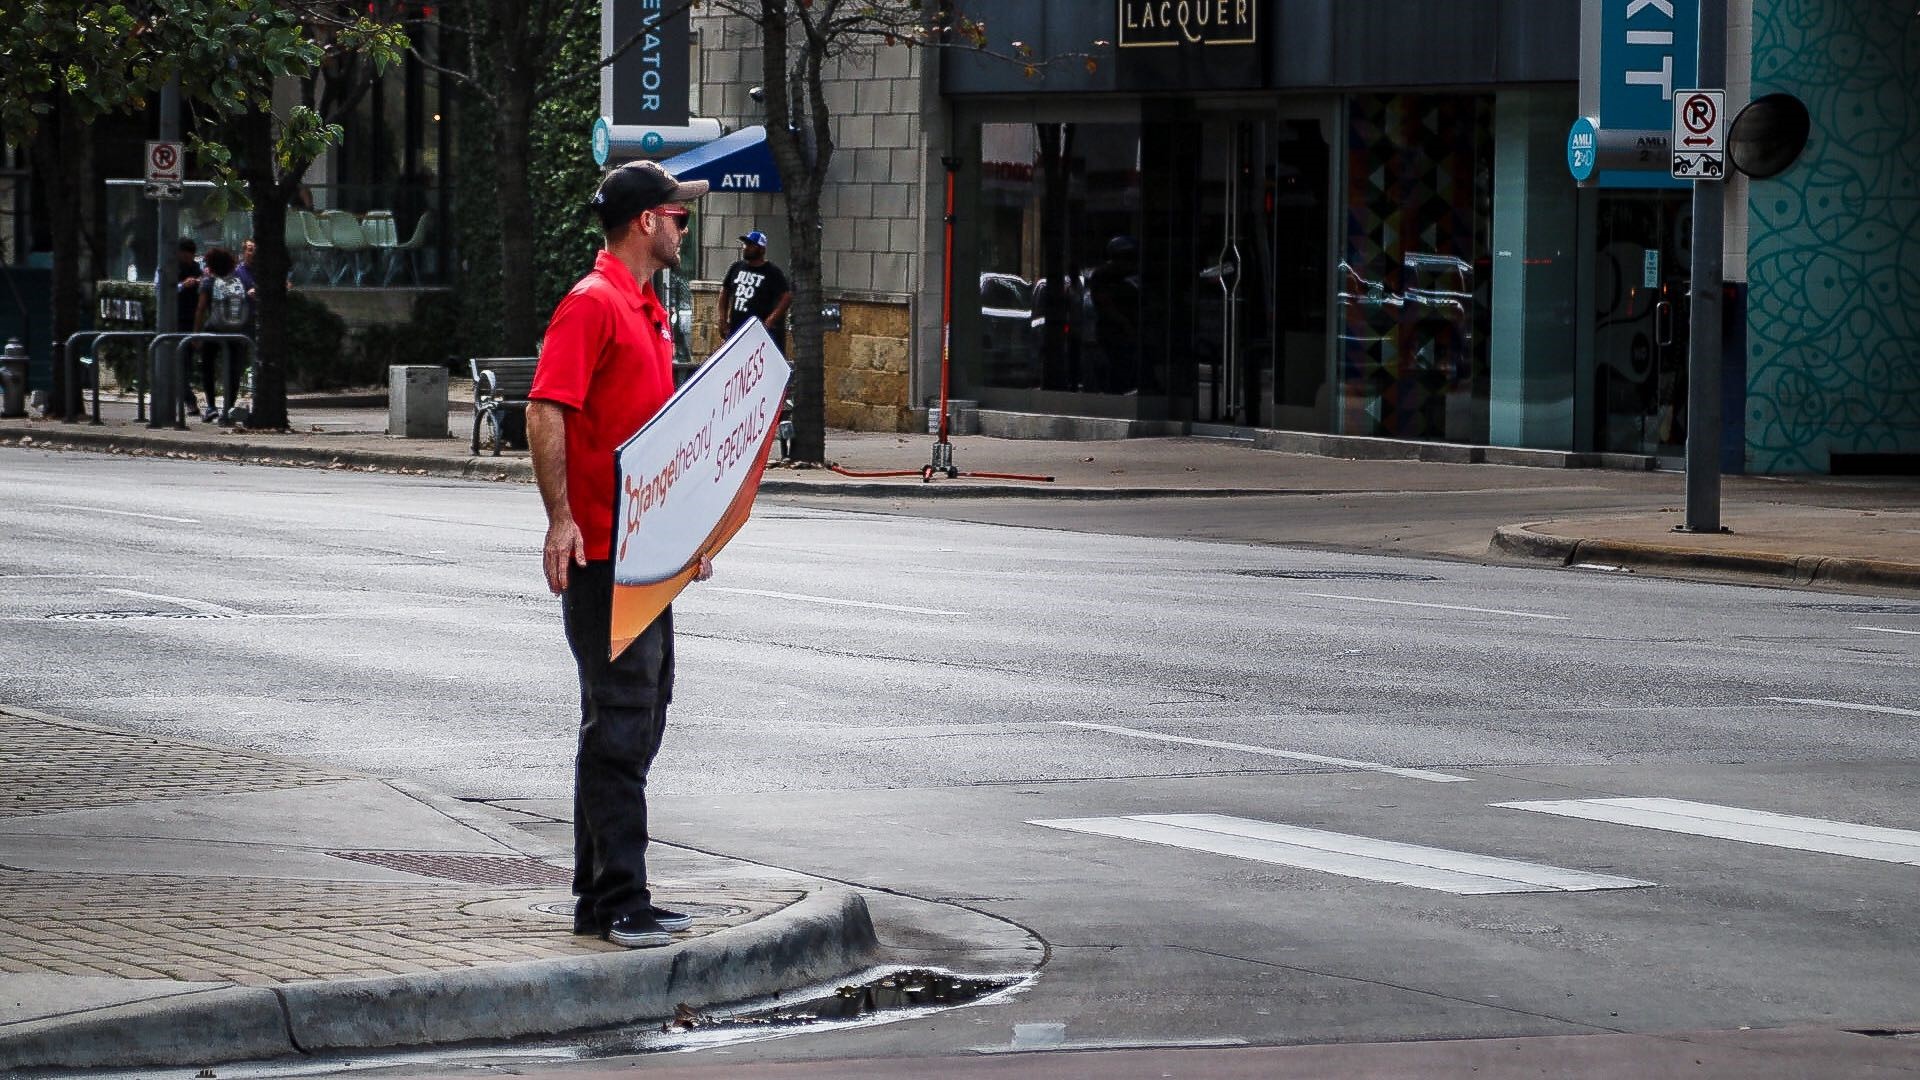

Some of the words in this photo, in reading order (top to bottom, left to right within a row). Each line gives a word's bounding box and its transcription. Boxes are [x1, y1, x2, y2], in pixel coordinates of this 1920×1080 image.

[1127, 0, 1247, 42] LACQUER
[1572, 133, 1592, 147] AMLI
[721, 174, 760, 188] ATM
[733, 270, 765, 288] JUST
[735, 284, 755, 298] DO
[734, 297, 748, 312] IT.
[722, 341, 766, 421] FITNESS
[714, 397, 766, 483] SPECIALS
